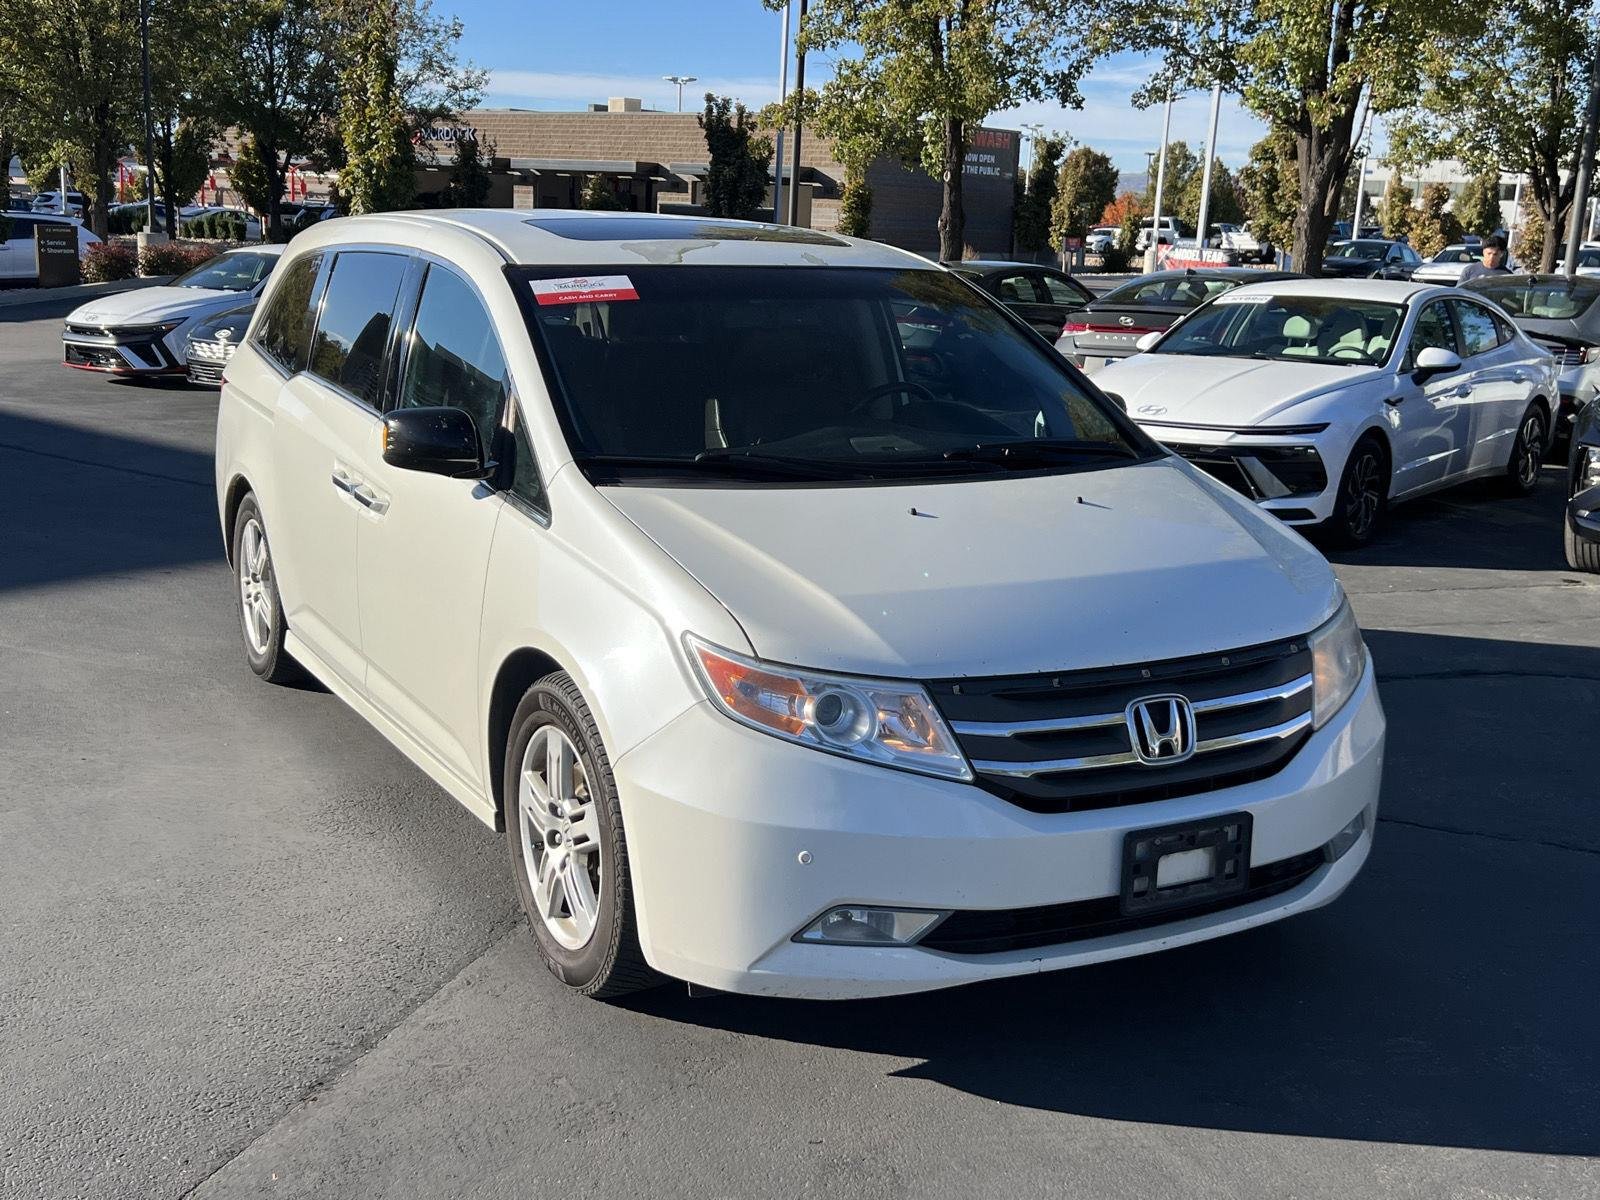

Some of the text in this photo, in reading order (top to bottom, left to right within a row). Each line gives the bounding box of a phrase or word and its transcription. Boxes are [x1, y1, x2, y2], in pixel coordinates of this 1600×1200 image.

[974, 131, 1011, 149] WASH
[979, 154, 996, 163] OPEN
[967, 165, 978, 174] THE
[979, 167, 1001, 176] PUBLIC
